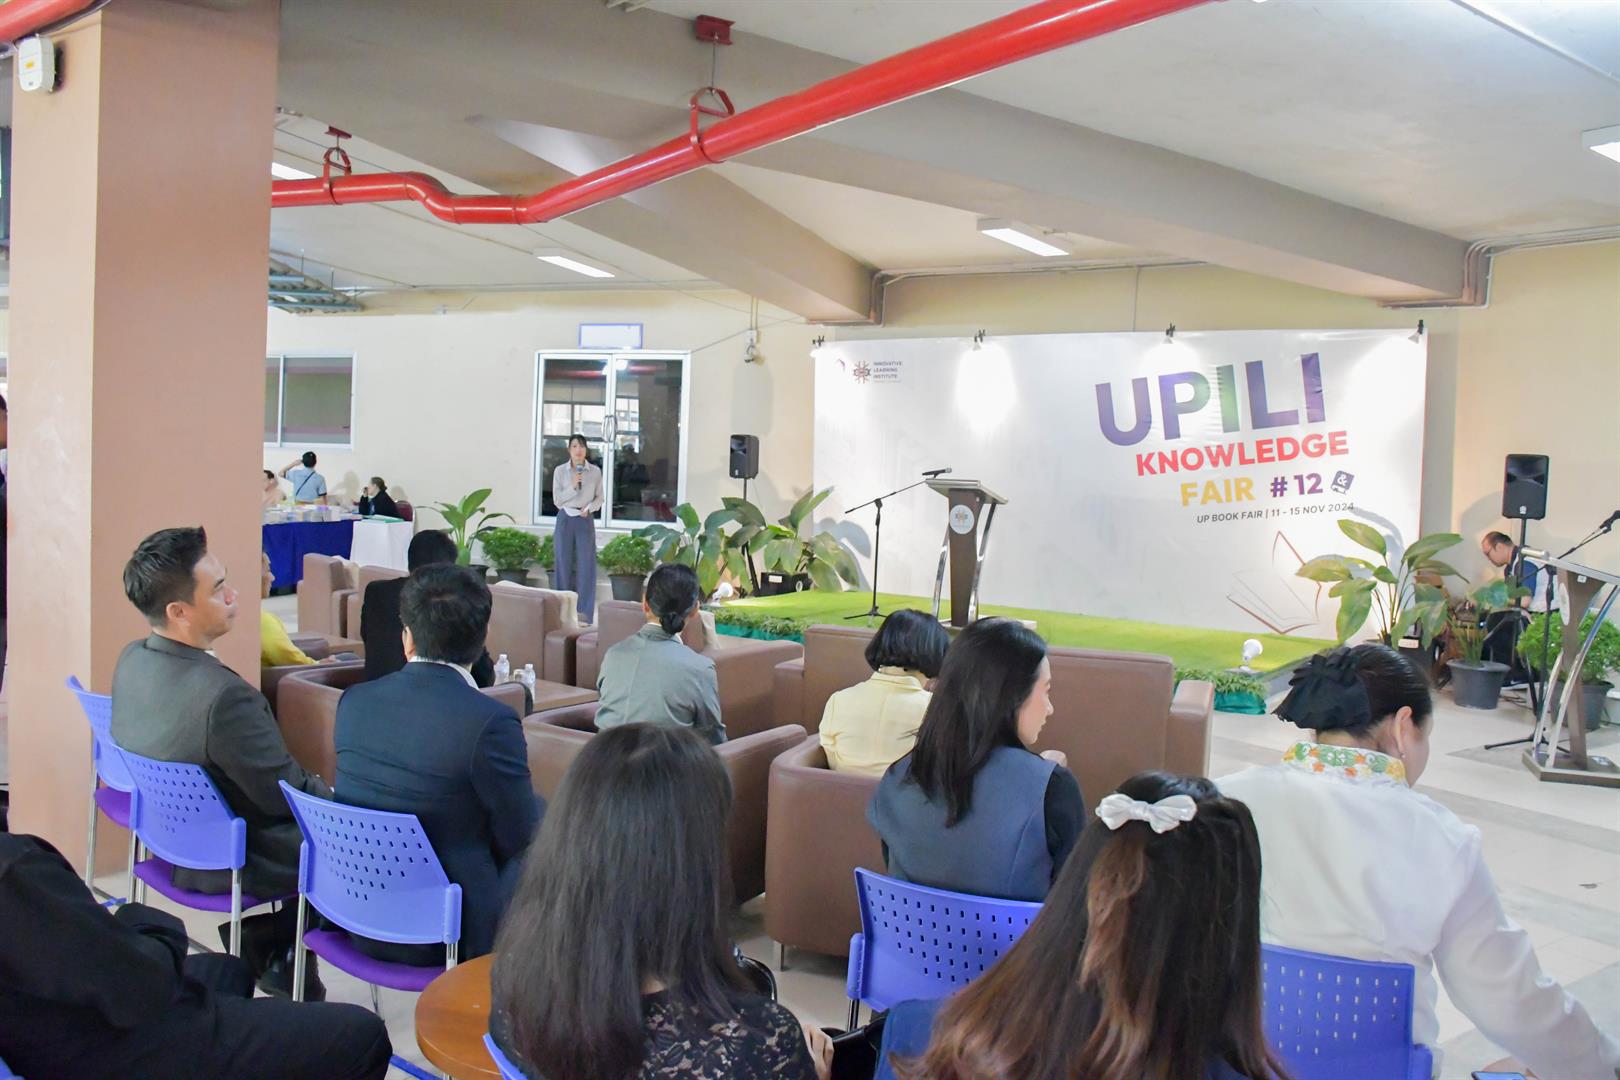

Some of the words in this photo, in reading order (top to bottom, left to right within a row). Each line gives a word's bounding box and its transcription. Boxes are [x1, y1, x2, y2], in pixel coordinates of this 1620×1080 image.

[1095, 352, 1326, 447] UPILI
[1136, 431, 1349, 476] KNOWLEDGE
[1180, 477, 1256, 507] FAIR
[1294, 473, 1323, 495] 12
[1196, 515, 1210, 524] UP
[1212, 512, 1239, 522] BOOK
[1241, 510, 1263, 520] FAIR
[1271, 509, 1280, 517] 11
[1290, 507, 1300, 516] 15
[1302, 504, 1326, 515] NOV
[1328, 502, 1354, 513] 2024
